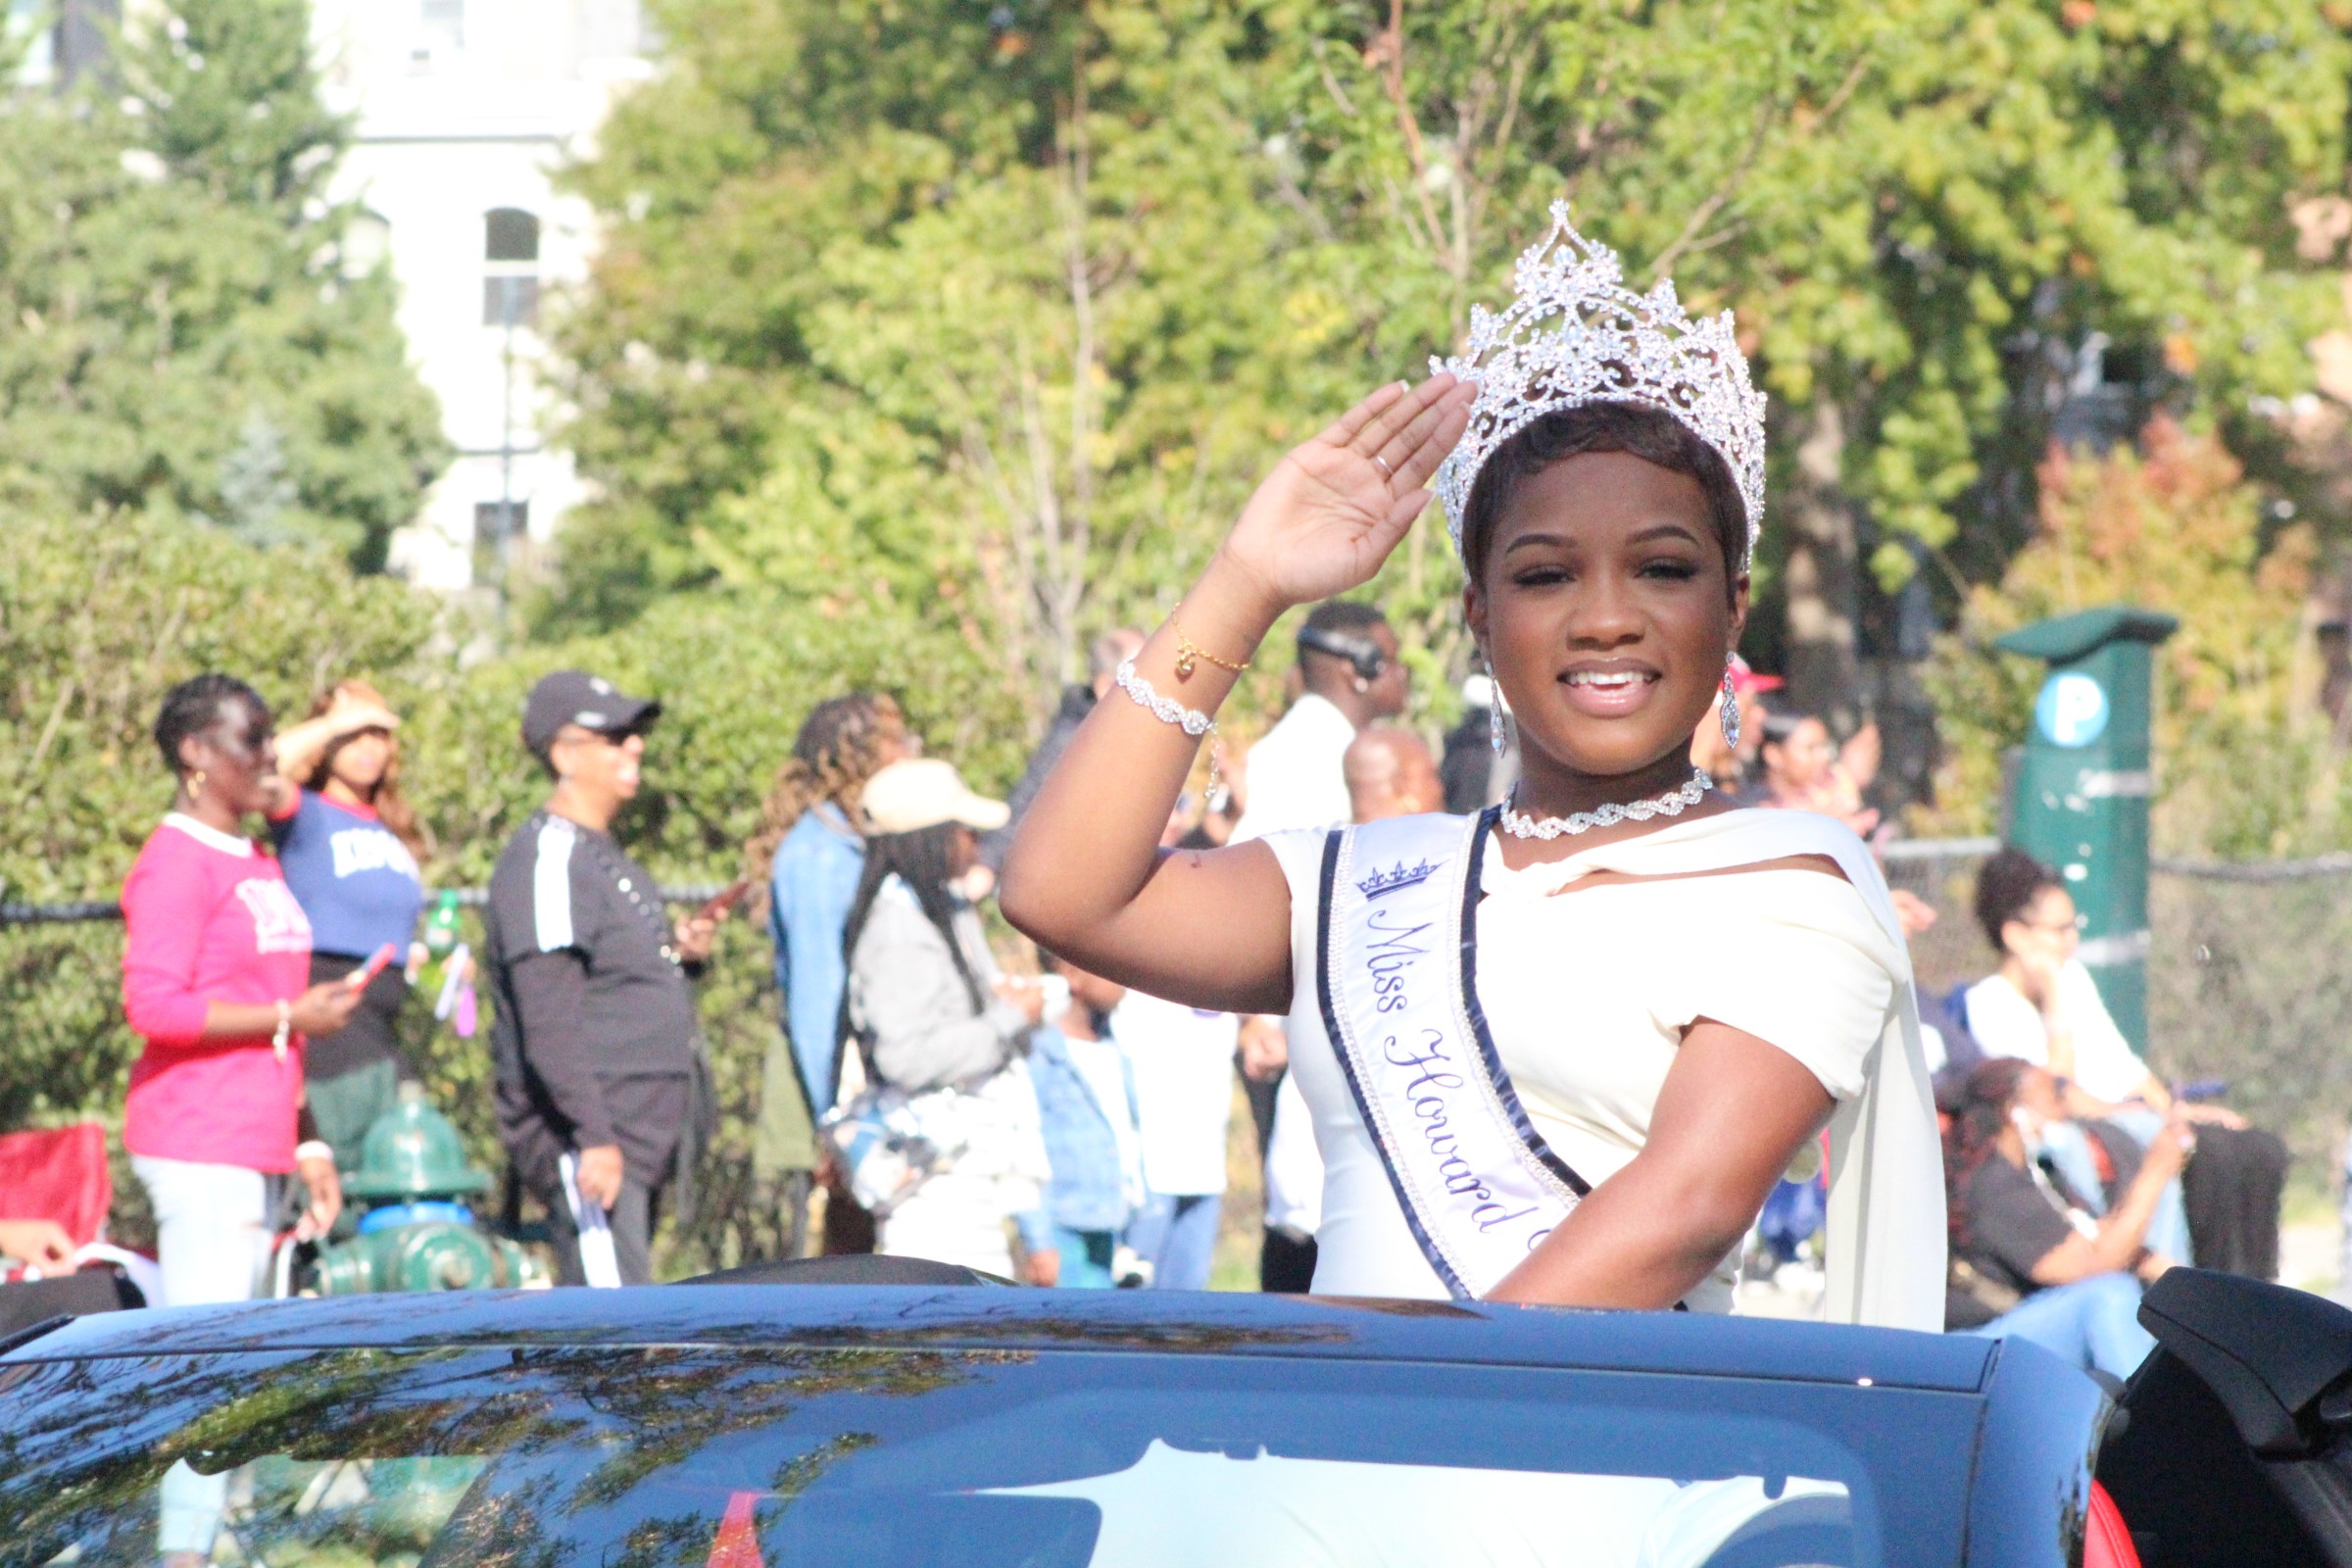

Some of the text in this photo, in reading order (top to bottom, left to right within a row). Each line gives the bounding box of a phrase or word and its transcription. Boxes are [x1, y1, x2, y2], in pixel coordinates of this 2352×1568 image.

[2055, 676, 2103, 743] P
[1366, 909, 1539, 1234] Miss Howard
